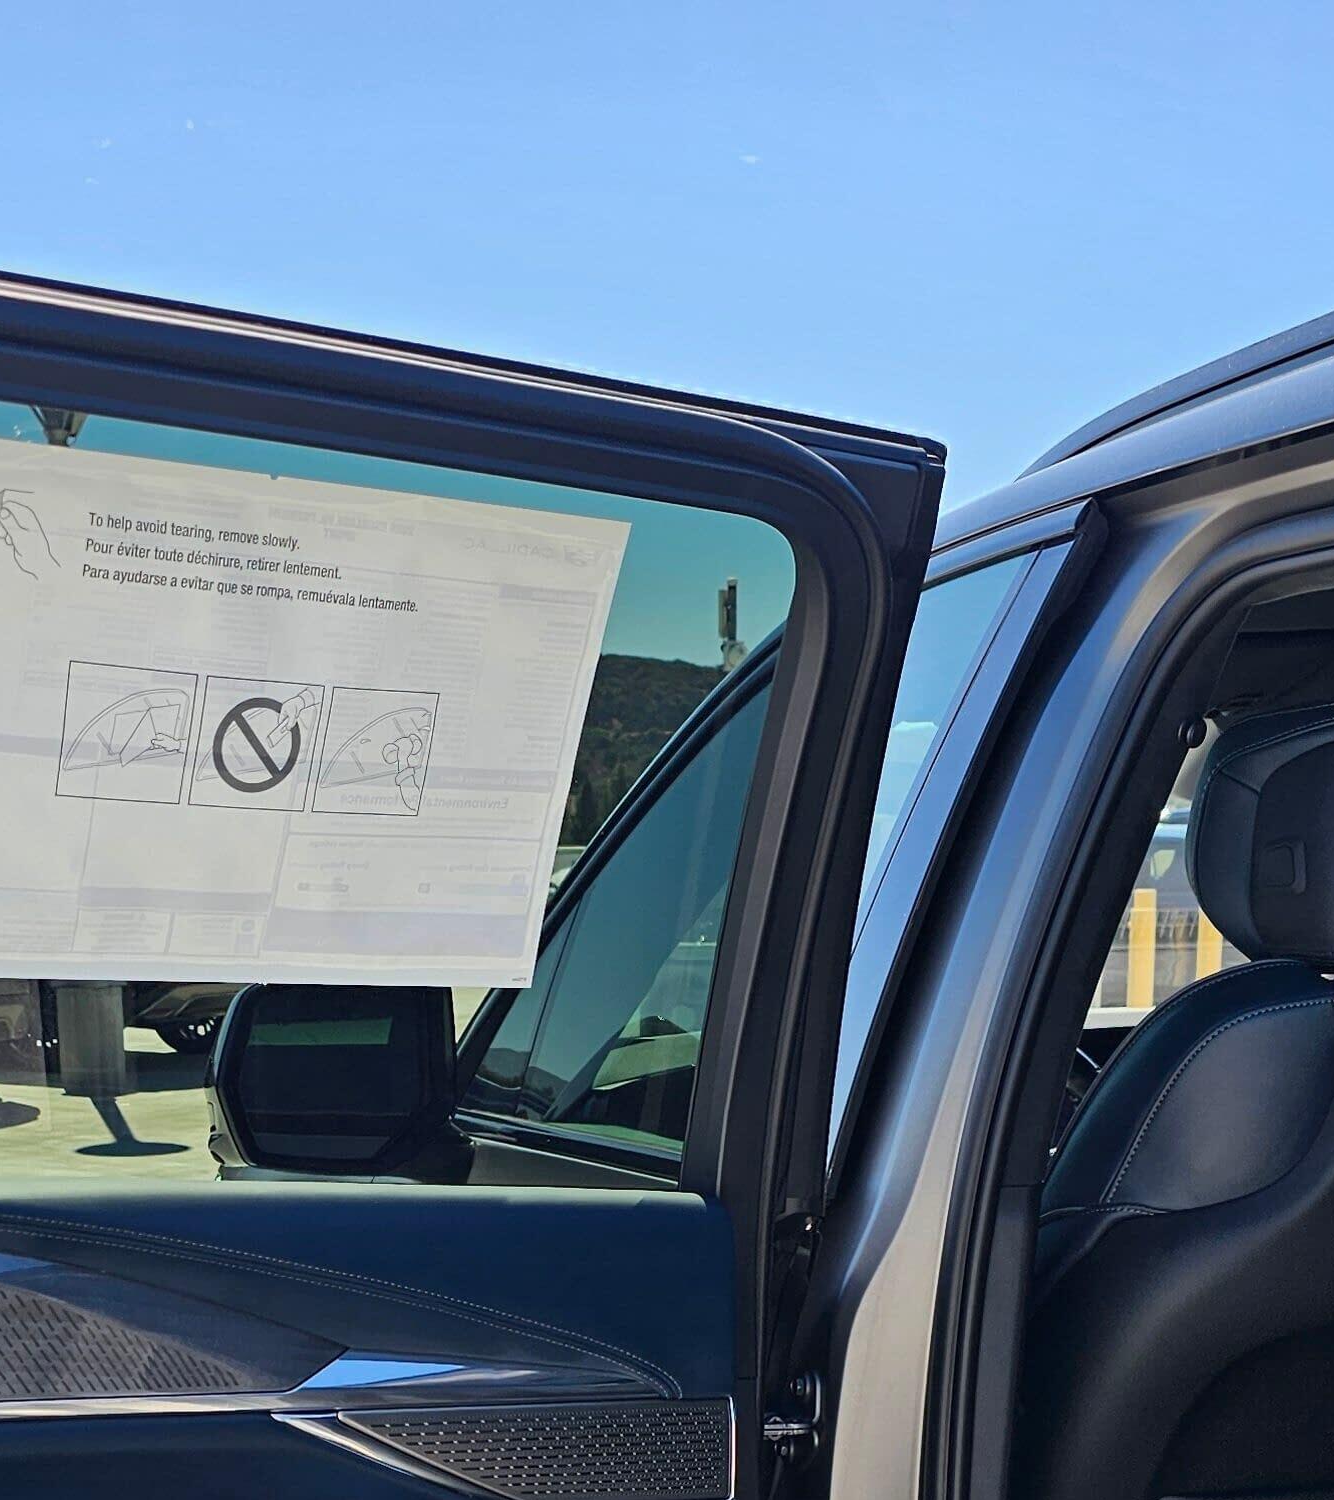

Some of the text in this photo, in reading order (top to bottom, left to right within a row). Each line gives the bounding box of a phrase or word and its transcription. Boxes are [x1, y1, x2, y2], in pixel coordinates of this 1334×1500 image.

[89, 512, 300, 552] To help avoid tearing, remove slowly.
[85, 538, 342, 580] Pour éviter toute déchirure, retirer lentement.
[82, 563, 418, 613] Para ayudarse a evitar que se rompa, remuévala lentamente.
